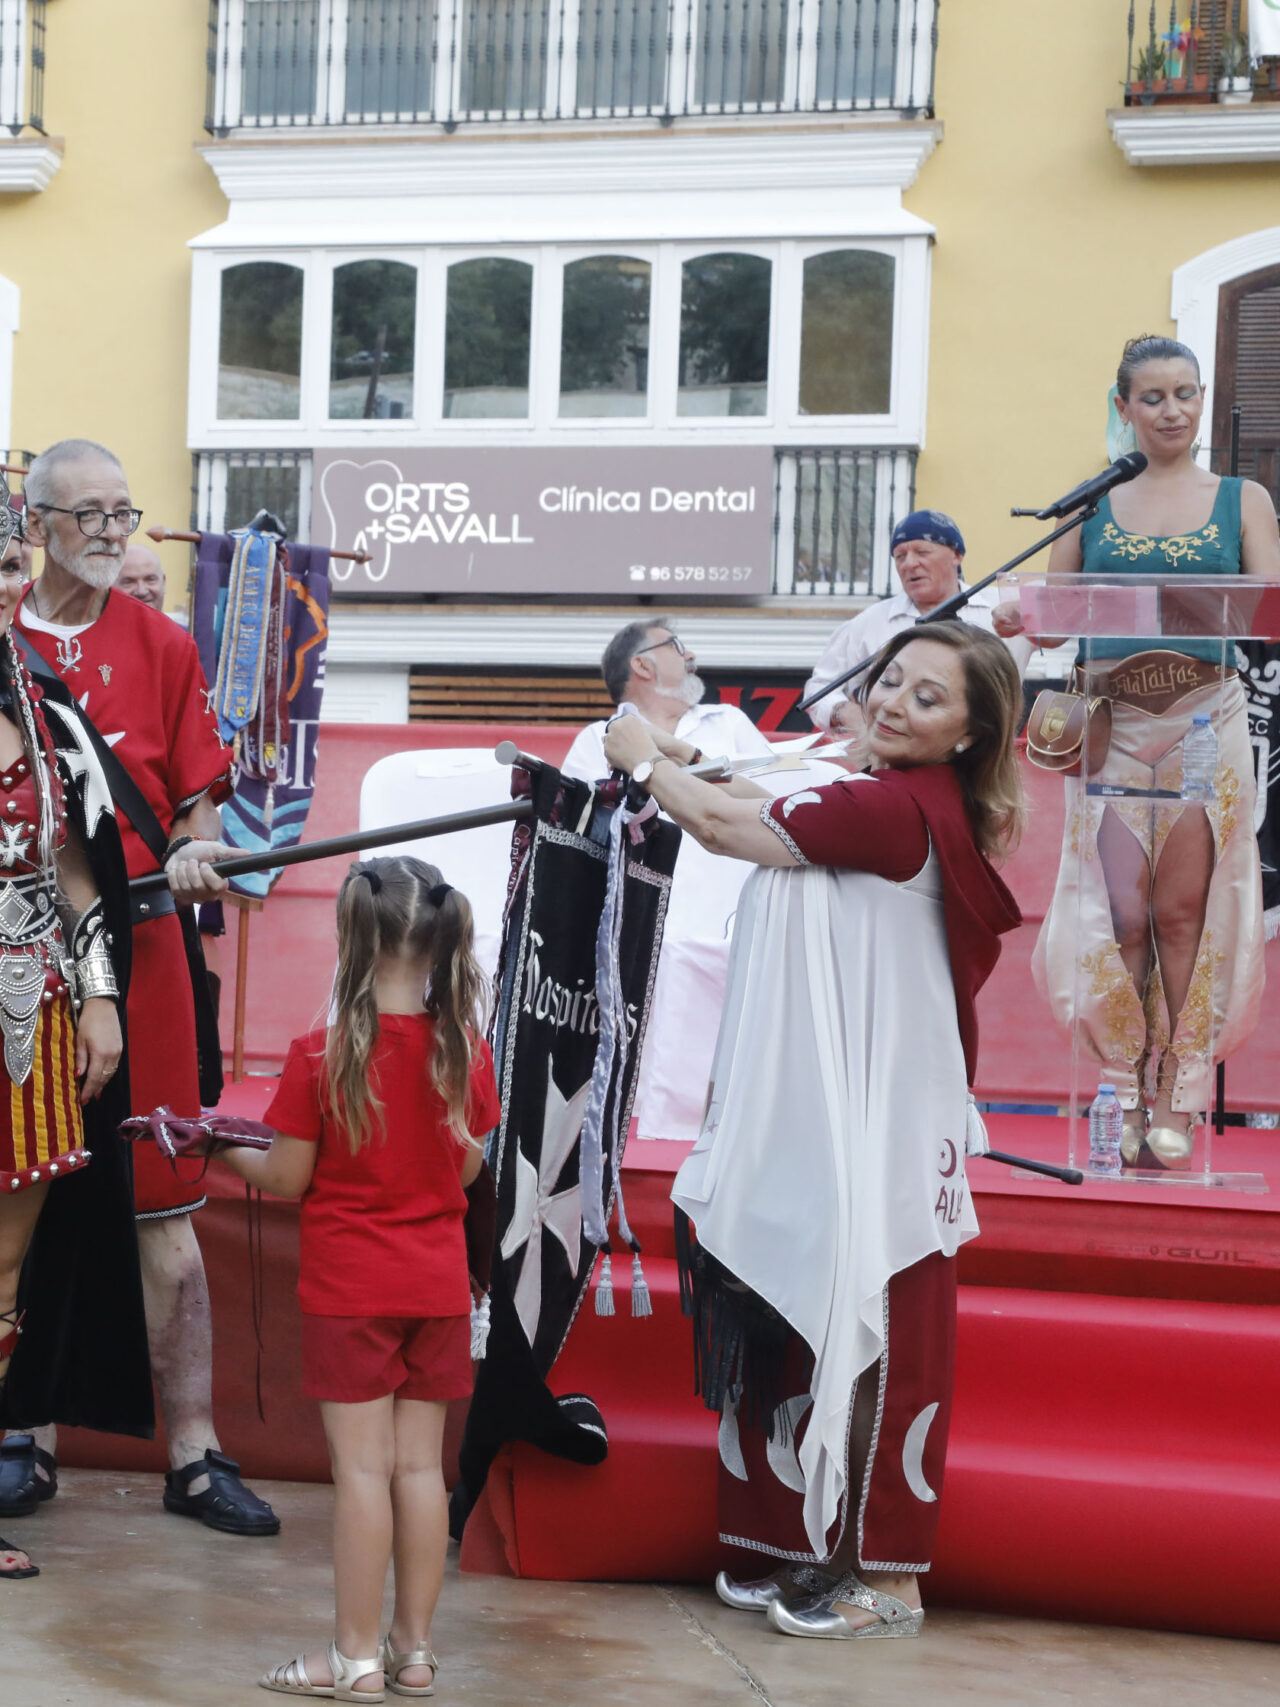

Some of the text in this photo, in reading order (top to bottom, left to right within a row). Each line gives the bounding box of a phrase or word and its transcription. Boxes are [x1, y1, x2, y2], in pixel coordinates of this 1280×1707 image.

[365, 482, 470, 514] ORTS
[538, 485, 756, 514] Clínica Dental
[674, 566, 705, 581] 578
[708, 566, 729, 581] 52
[732, 566, 752, 581] 57
